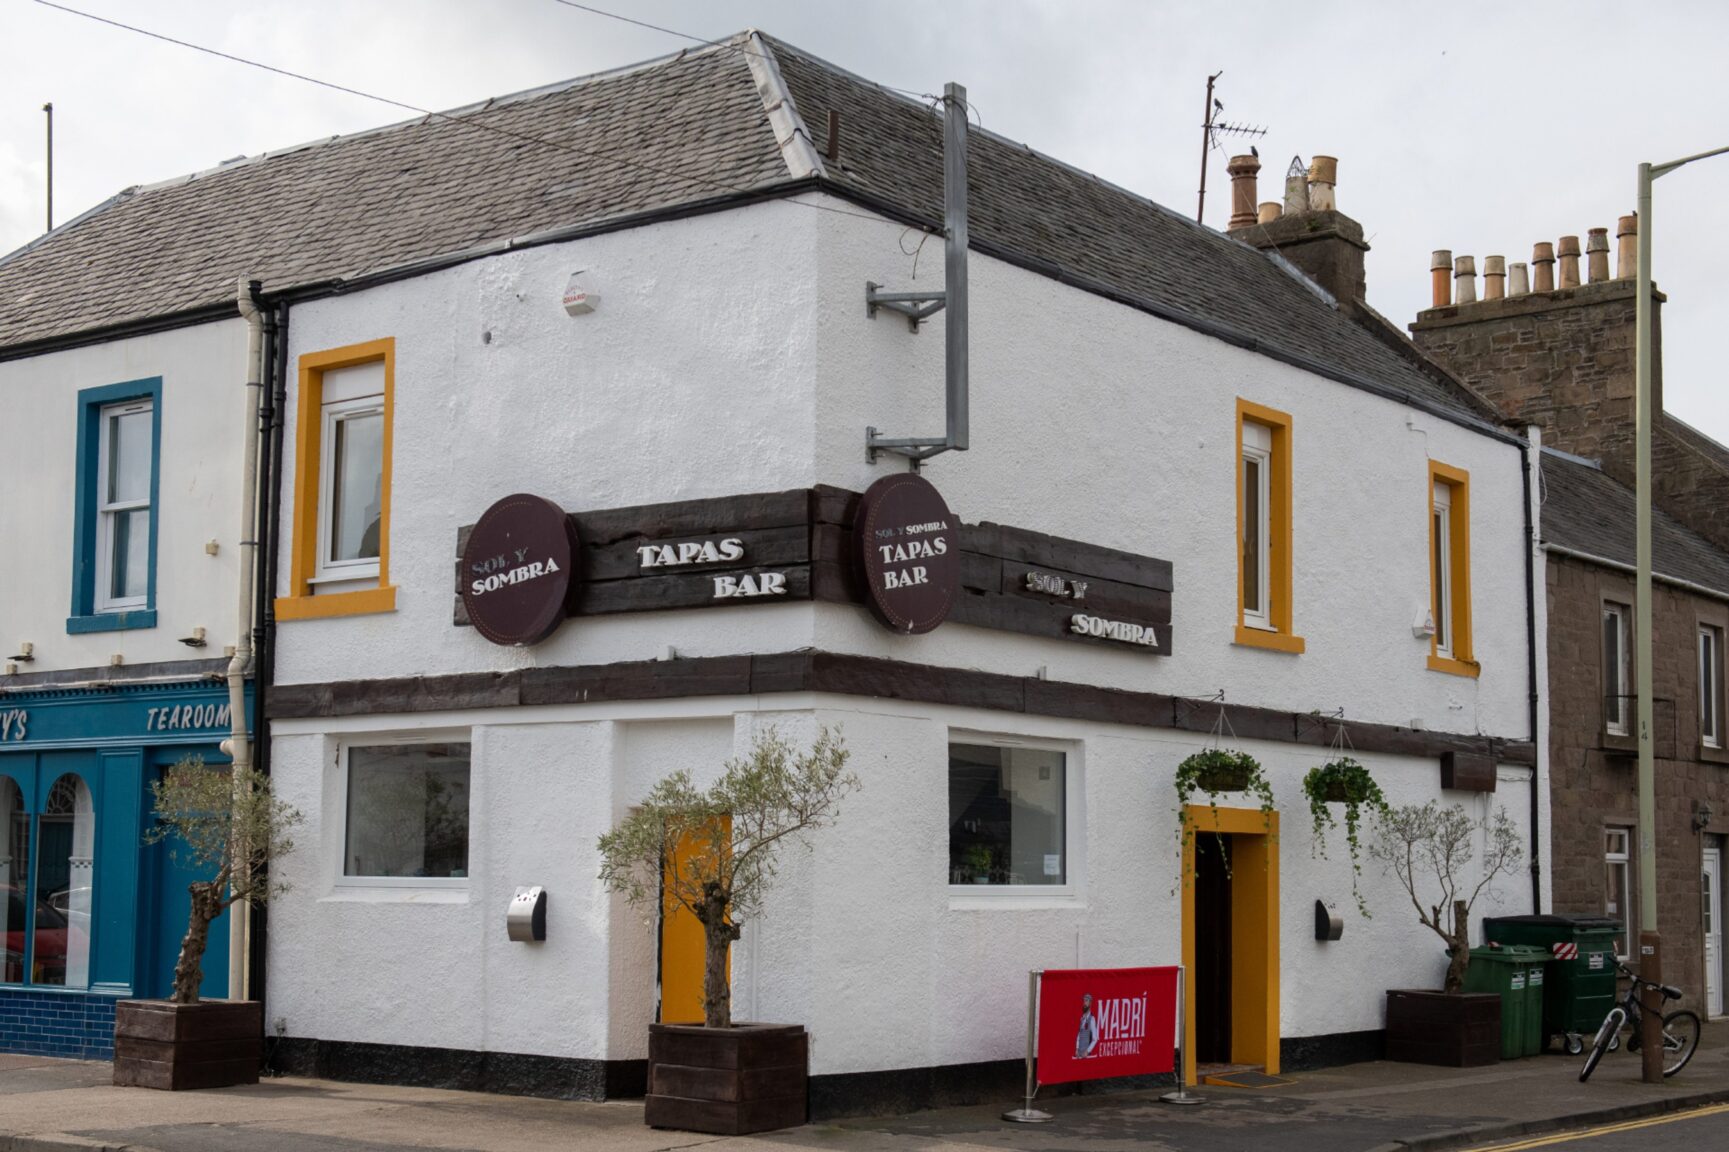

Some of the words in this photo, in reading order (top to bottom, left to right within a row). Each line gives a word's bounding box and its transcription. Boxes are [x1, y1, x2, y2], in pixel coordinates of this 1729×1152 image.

[876, 527, 896, 539] SOL
[896, 526, 904, 536] Y
[906, 520, 948, 535] SOMBRA
[471, 553, 510, 576] SOL
[514, 547, 528, 562] Y
[636, 538, 744, 567] TAPAS
[879, 537, 947, 564] TAPAS
[471, 557, 560, 596] SOMBRA
[713, 572, 787, 598] BAR
[884, 566, 929, 590] BAR
[1026, 571, 1070, 597] SOL
[1069, 580, 1088, 599] Y
[1070, 613, 1159, 647] SOMBRA
[0, 709, 27, 741] Y'S
[1097, 991, 1147, 1040] MADRÍ
